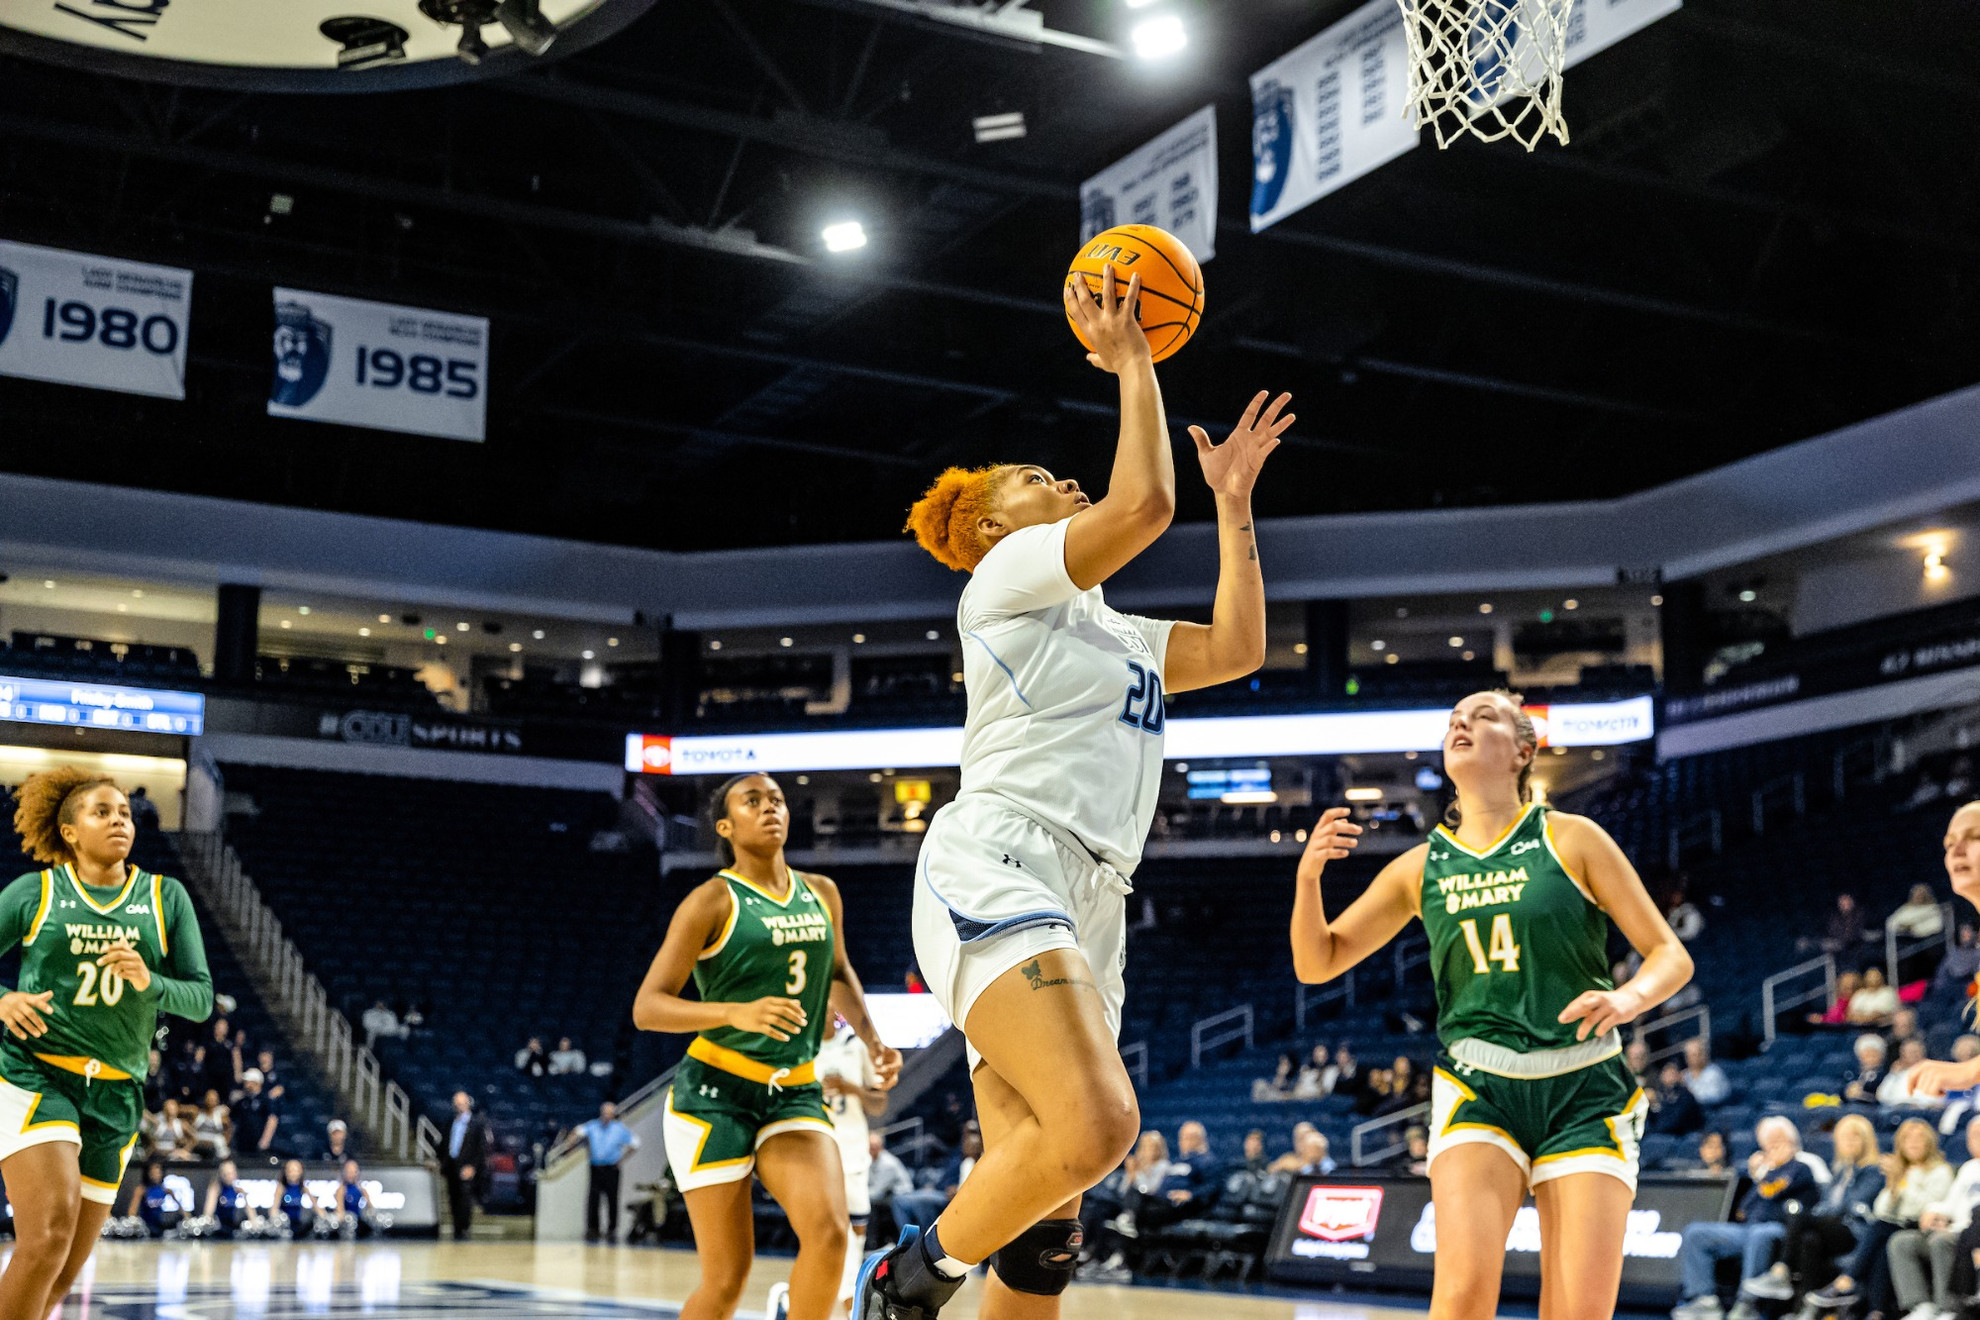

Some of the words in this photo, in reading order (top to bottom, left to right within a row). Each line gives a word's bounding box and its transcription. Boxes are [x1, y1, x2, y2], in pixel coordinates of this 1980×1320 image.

[1087, 244, 1141, 266] EVO
[43, 297, 179, 356] 1980
[355, 345, 479, 400] 1985
[1118, 659, 1165, 736] 20
[1437, 866, 1530, 895] WILLIAM
[64, 923, 141, 941] WILLIAM
[761, 913, 827, 930] WILLIAM
[1459, 913, 1521, 974] 14
[72, 961, 124, 1007] 20
[785, 949, 808, 996] 3
